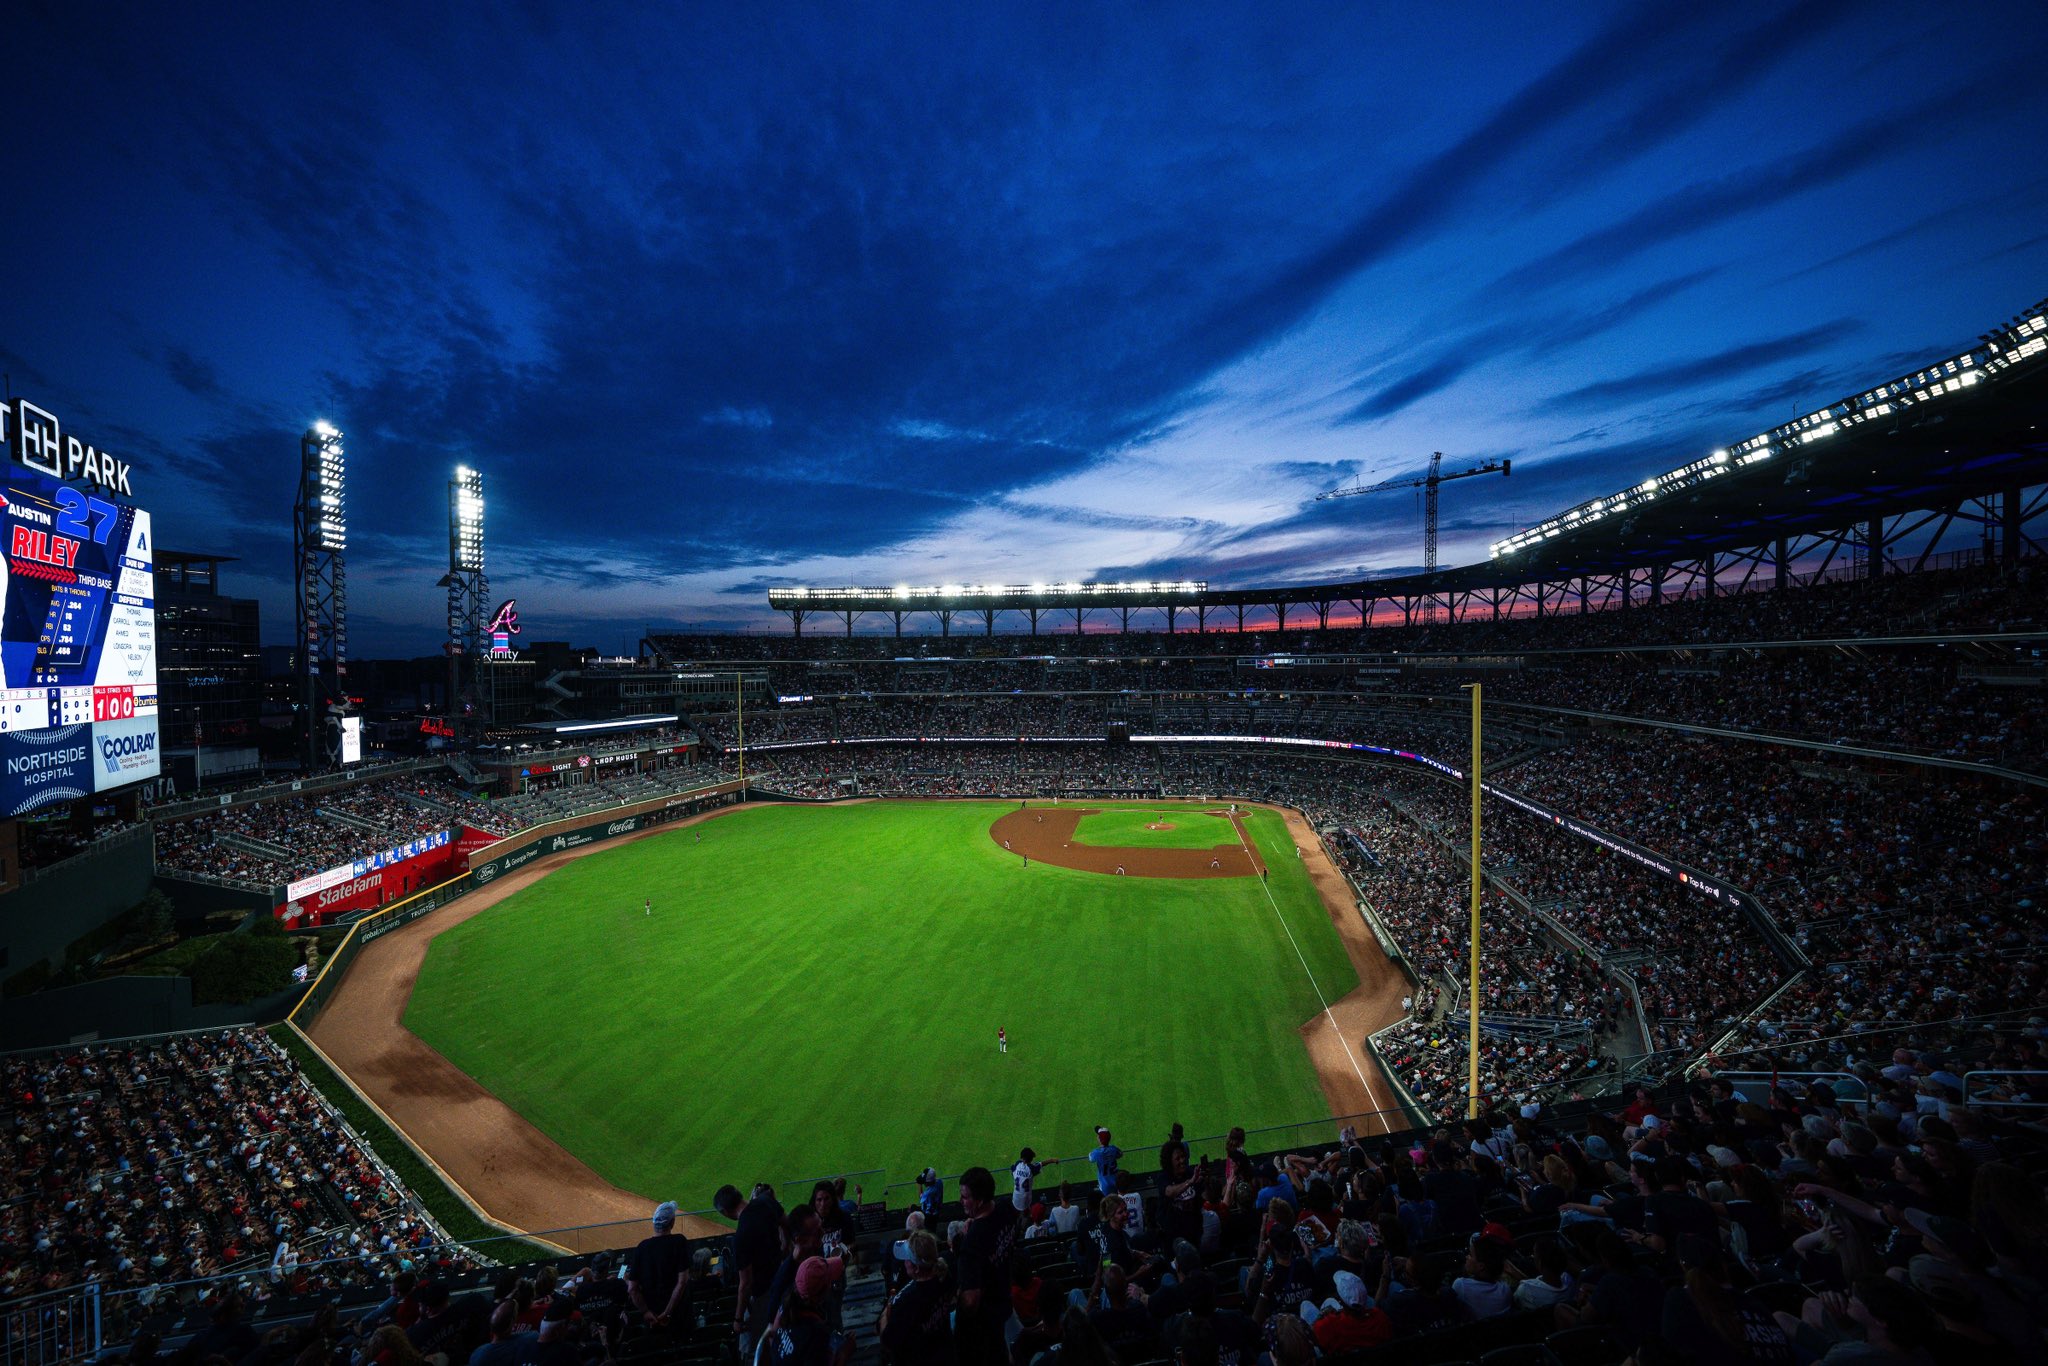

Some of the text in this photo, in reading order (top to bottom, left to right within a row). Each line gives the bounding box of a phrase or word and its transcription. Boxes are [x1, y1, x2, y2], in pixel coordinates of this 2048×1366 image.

[68, 435, 132, 497] PARK
[8, 503, 51, 526] AUSTIN
[56, 487, 118, 545] 27
[12, 525, 80, 568] RILEY
[78, 574, 112, 589] THIRD BASE
[118, 594, 144, 606] DEFENSE
[126, 607, 142, 617] THOMAS
[113, 617, 130, 626] CARROLL
[127, 653, 142, 661] NELSON
[15, 691, 19, 699] 7
[27, 690, 31, 698] 8
[38, 690, 43, 698] 9
[51, 690, 56, 698] R
[81, 688, 92, 696] LOB
[138, 696, 158, 706] bumble
[1, 700, 89, 714] 1 0 4 6 0 5
[97, 697, 132, 719] 1 0 0
[1, 720, 7, 730] 0
[53, 715, 57, 724] 1
[64, 715, 69, 723] 2
[103, 732, 156, 760] COOLRAY
[7, 746, 87, 775] NORTHSIDE
[615, 753, 638, 762] HOUSE
[552, 763, 572, 771] LIGHT
[24, 766, 75, 786] HOSPITAL
[608, 818, 637, 835] Coca-Cola
[511, 849, 538, 865] Georgia Power
[1620, 846, 1630, 856] back
[1635, 853, 1644, 861] the
[1643, 858, 1657, 868] game
[1656, 862, 1672, 875] faster.
[355, 863, 365, 873] NL
[479, 865, 495, 878] Ford
[318, 872, 383, 908] StateFarm
[1688, 876, 1713, 894] Tap & go
[1728, 894, 1740, 907] Tap
[411, 906, 429, 918] TRUIST
[361, 919, 401, 943] globalpayments
[1015, 1176, 1030, 1193] 14
[1126, 1207, 1140, 1229] 2
